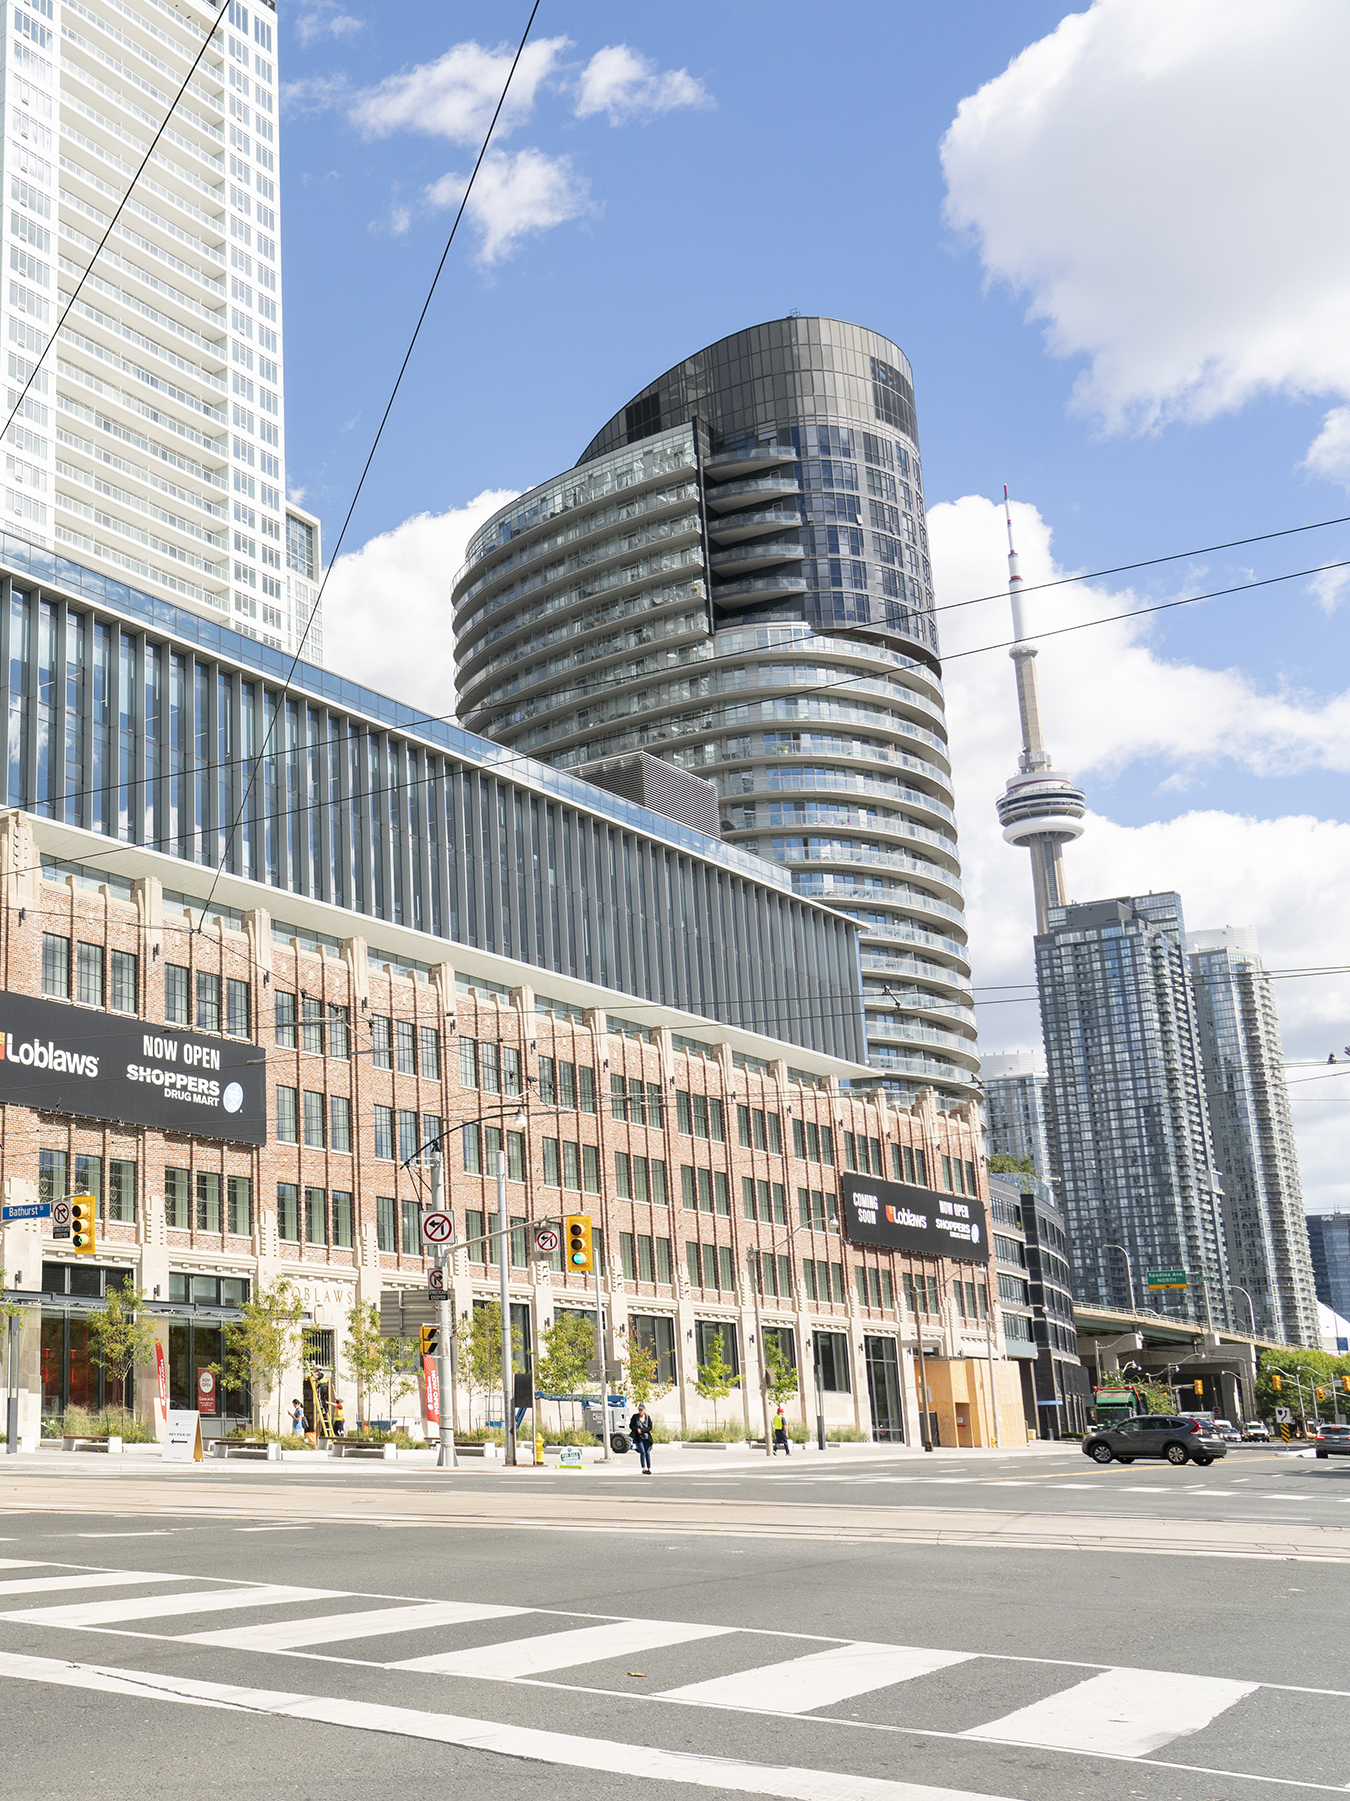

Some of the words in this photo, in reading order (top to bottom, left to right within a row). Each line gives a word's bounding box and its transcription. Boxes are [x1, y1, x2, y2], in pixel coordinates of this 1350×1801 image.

[6, 1032, 97, 1078] Loblaws
[143, 1034, 177, 1062] NOW
[184, 1044, 220, 1070] OPEN
[126, 1064, 220, 1096] SHOPPERS
[164, 1088, 191, 1102] DRUG
[193, 1093, 220, 1107] MART
[852, 1192, 878, 1210] COMING
[939, 1200, 953, 1216] NOW
[954, 1203, 969, 1218] OPEN
[9, 1207, 38, 1216] Bathurst
[858, 1208, 876, 1224] SOON
[893, 1206, 927, 1229] Loblaws
[935, 1218, 970, 1234] SHOPPERS
